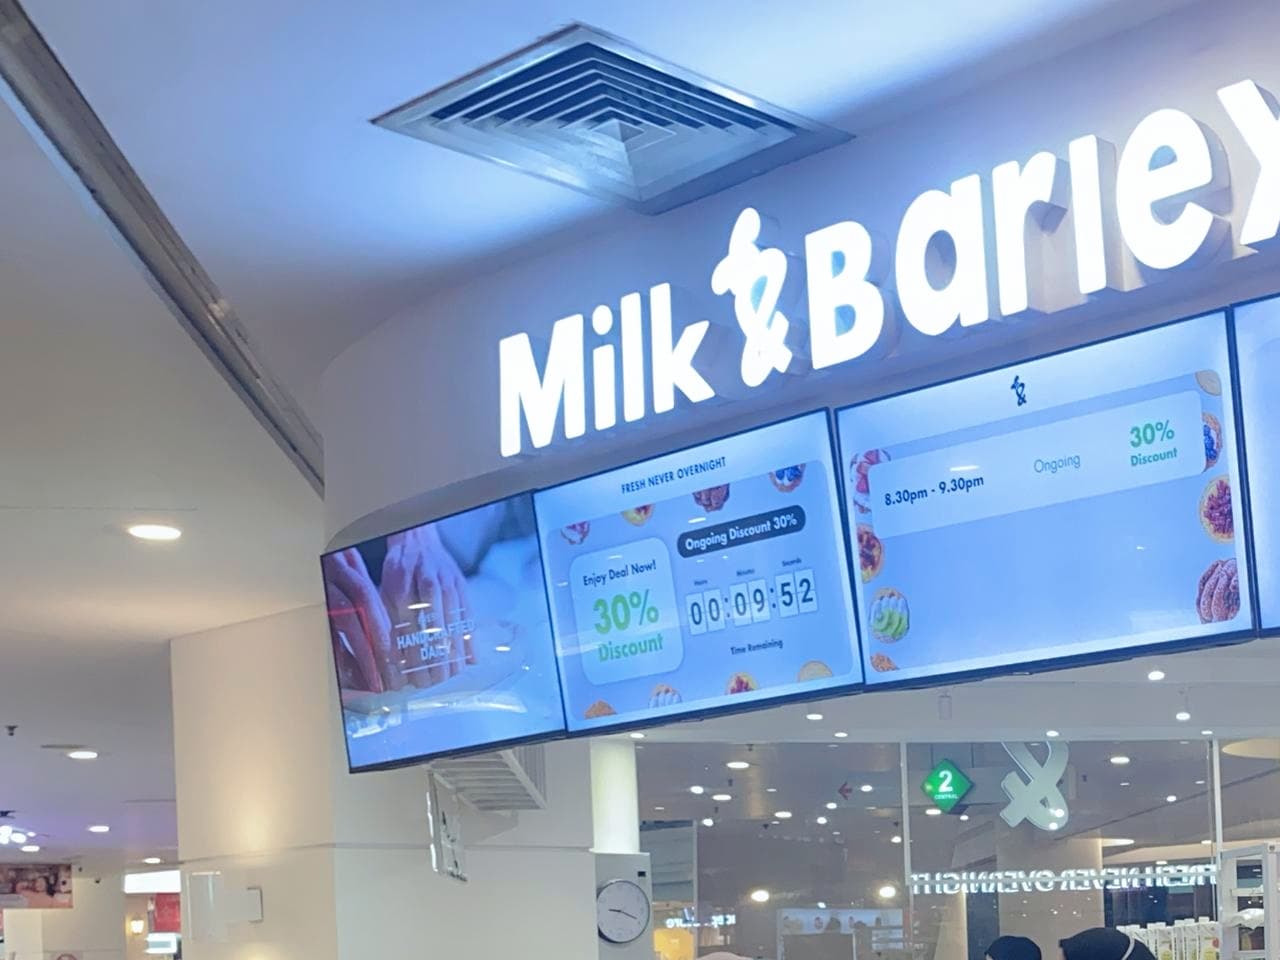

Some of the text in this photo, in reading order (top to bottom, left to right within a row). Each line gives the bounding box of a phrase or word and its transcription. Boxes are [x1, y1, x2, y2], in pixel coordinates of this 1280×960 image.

[498, 282, 715, 457] Milk
[1130, 419, 1175, 449] 30%
[1034, 453, 1081, 475] Ongoing
[1130, 447, 1178, 468] Discount
[621, 456, 726, 494] FRESH NEVER OVERNIGHT
[885, 483, 928, 507] 8.30pm
[938, 475, 985, 498] 9.30pm
[685, 513, 798, 550] Ongoing Discount 30%
[583, 559, 657, 588] Enjoy Deal Now!
[592, 589, 660, 635] 30%
[598, 633, 664, 663] Discount
[938, 770, 954, 793] 2
